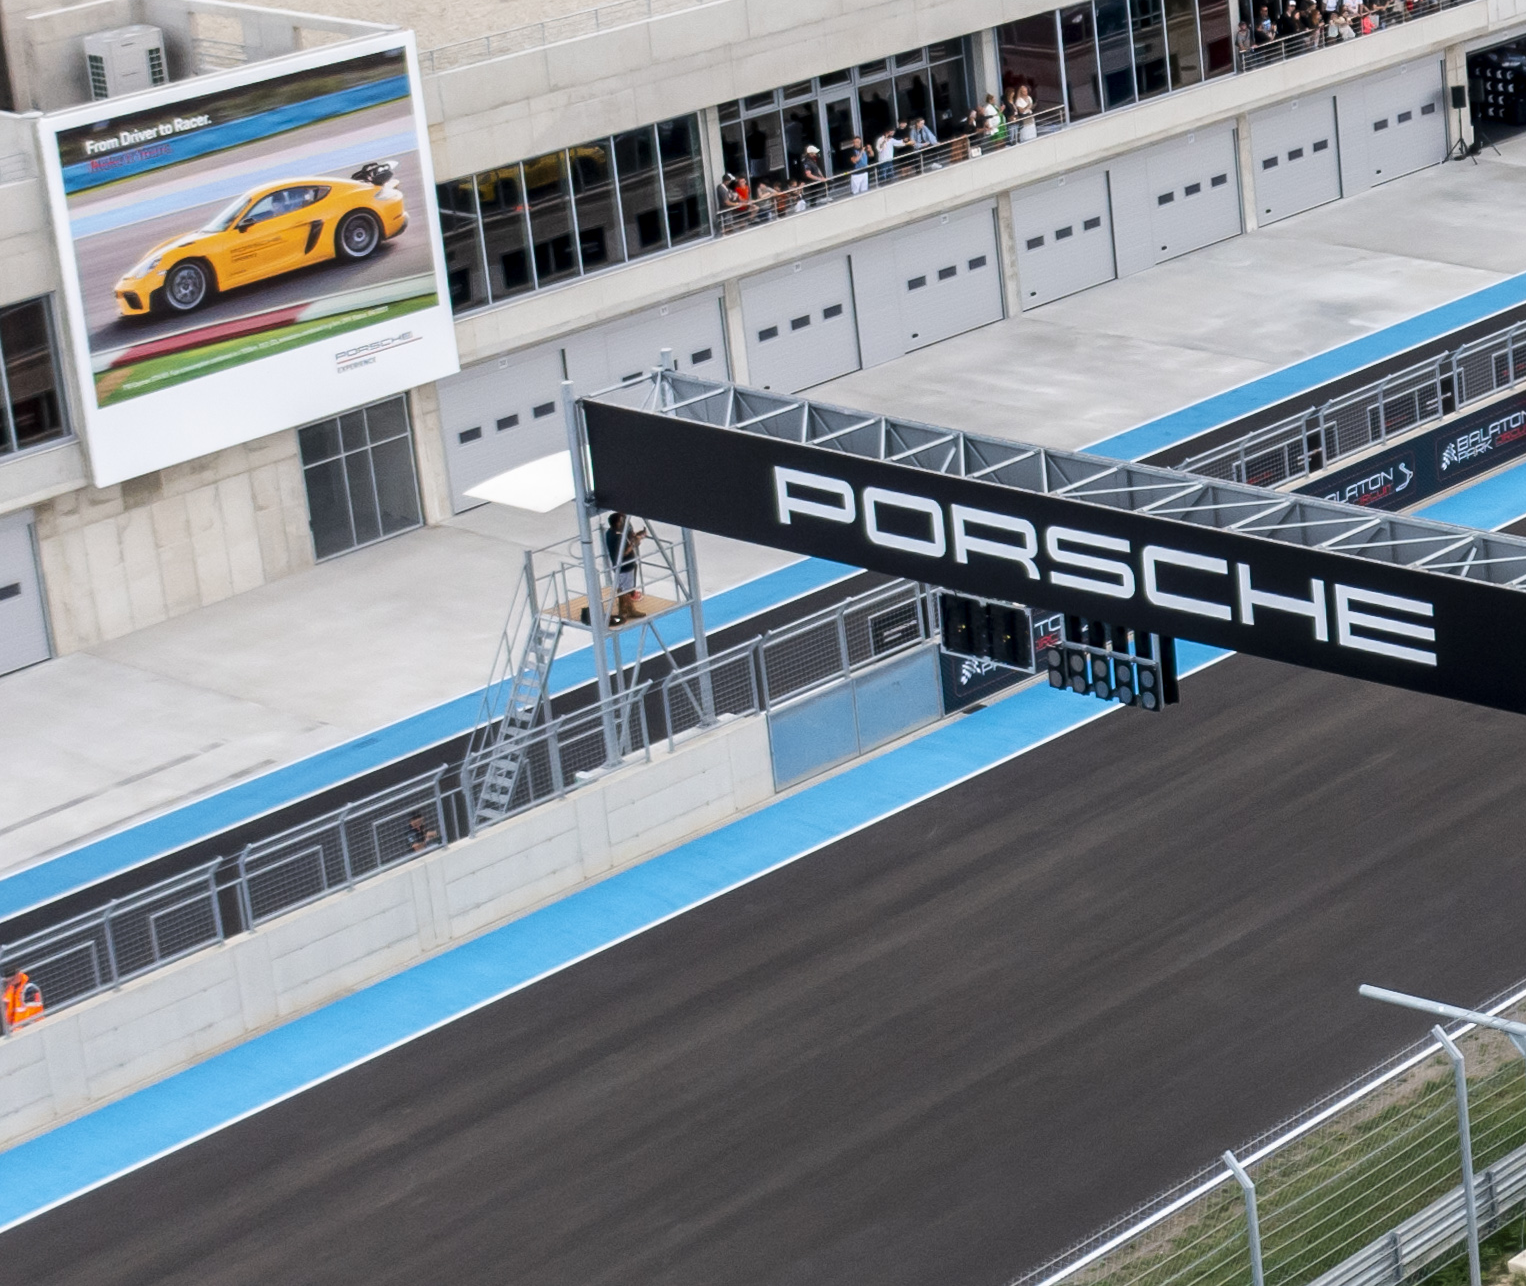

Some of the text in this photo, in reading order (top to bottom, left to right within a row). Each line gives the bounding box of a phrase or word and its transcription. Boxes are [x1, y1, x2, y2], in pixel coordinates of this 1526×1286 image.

[85, 114, 212, 155] From Driver to Racer.
[335, 330, 414, 361] PORSCHE
[337, 356, 376, 374] EXPERIENCE
[1457, 439, 1493, 464] PARK
[772, 465, 1438, 667] PORSCHE
